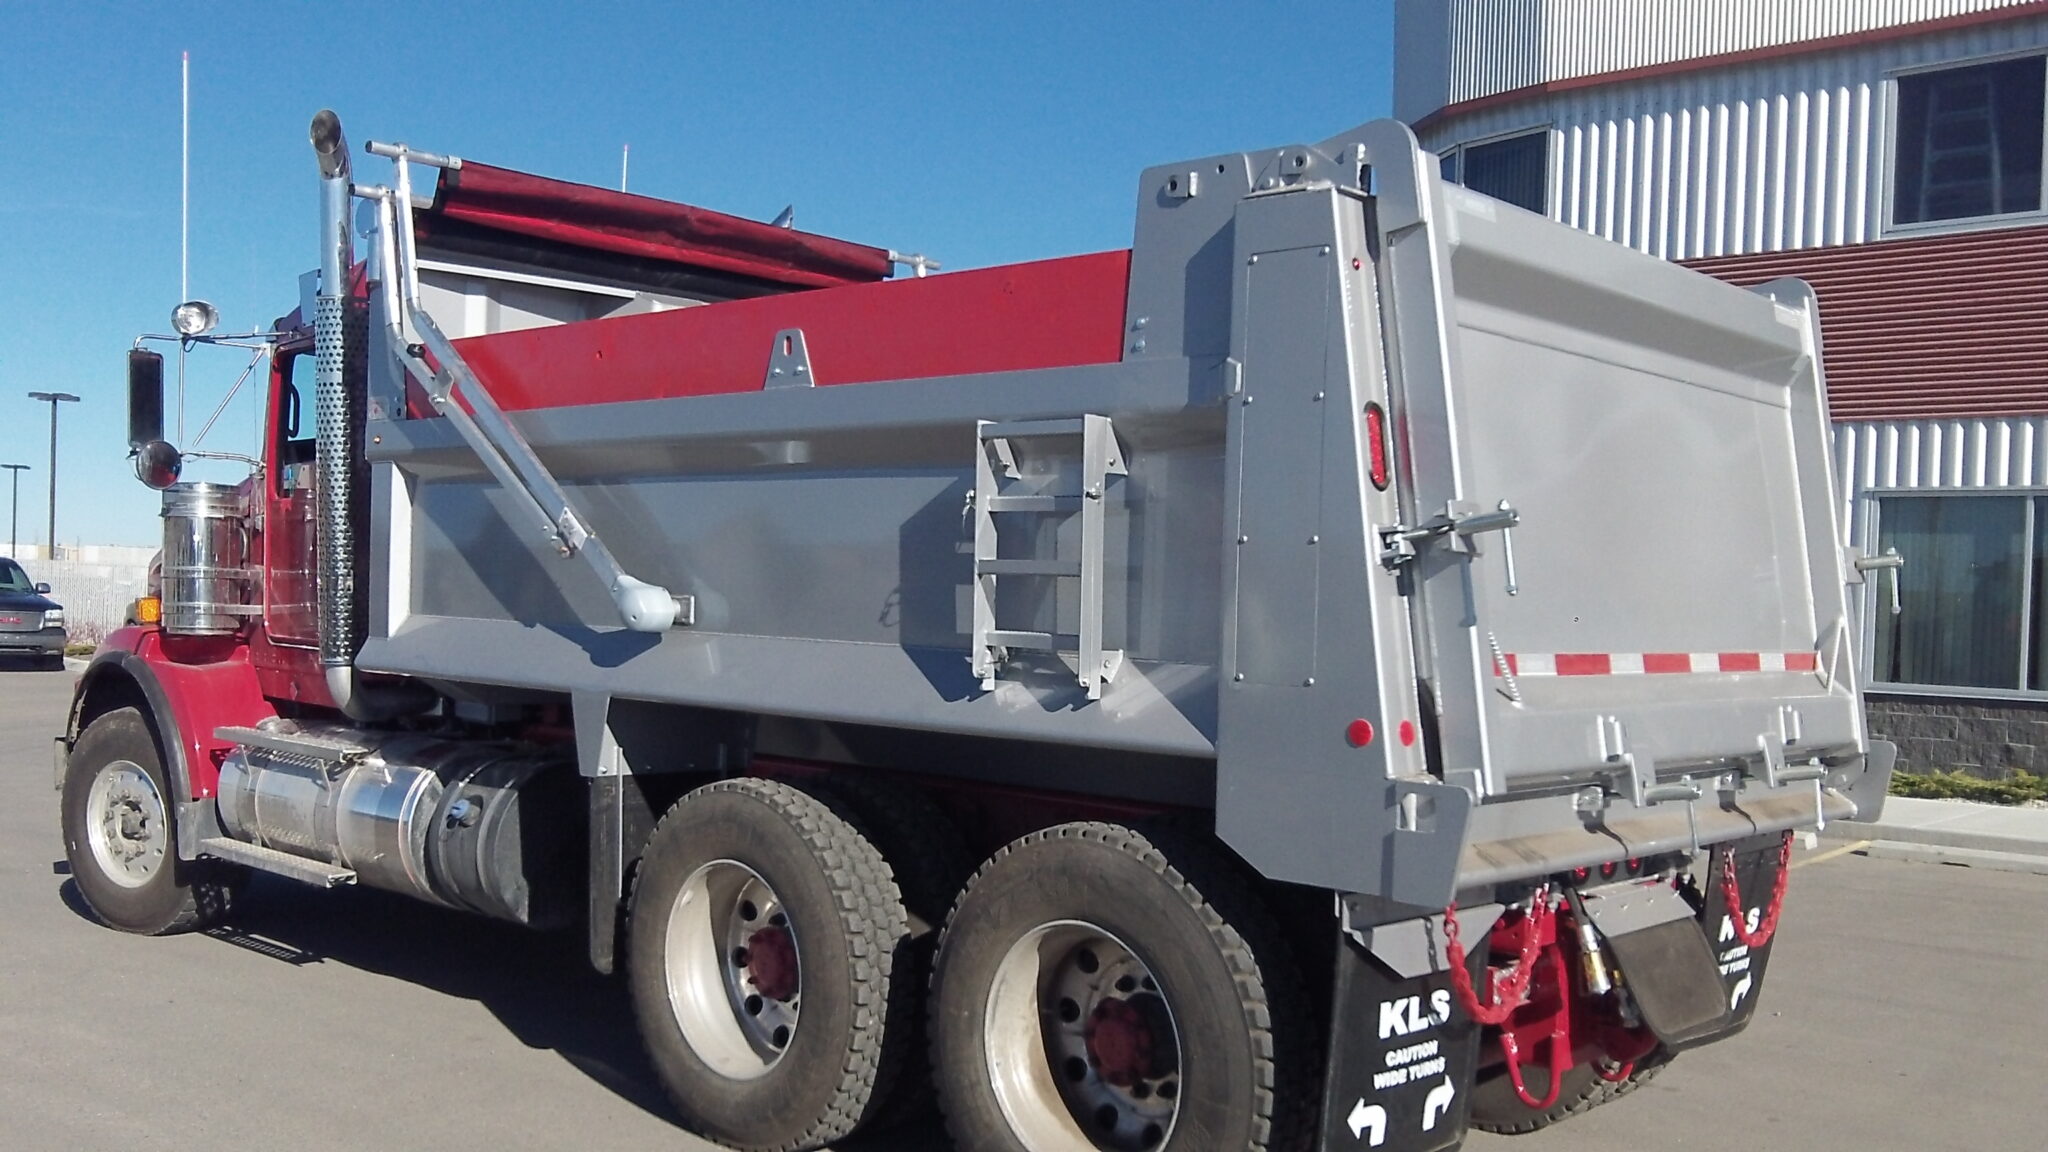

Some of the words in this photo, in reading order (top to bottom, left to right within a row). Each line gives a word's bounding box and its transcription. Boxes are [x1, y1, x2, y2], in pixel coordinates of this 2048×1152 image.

[1719, 907, 1760, 942] KS
[1379, 989, 1451, 1039] KLS
[1385, 1040, 1439, 1067] CAUTION
[1373, 1068, 1408, 1090] WIDE
[1408, 1056, 1446, 1081] TURNS
